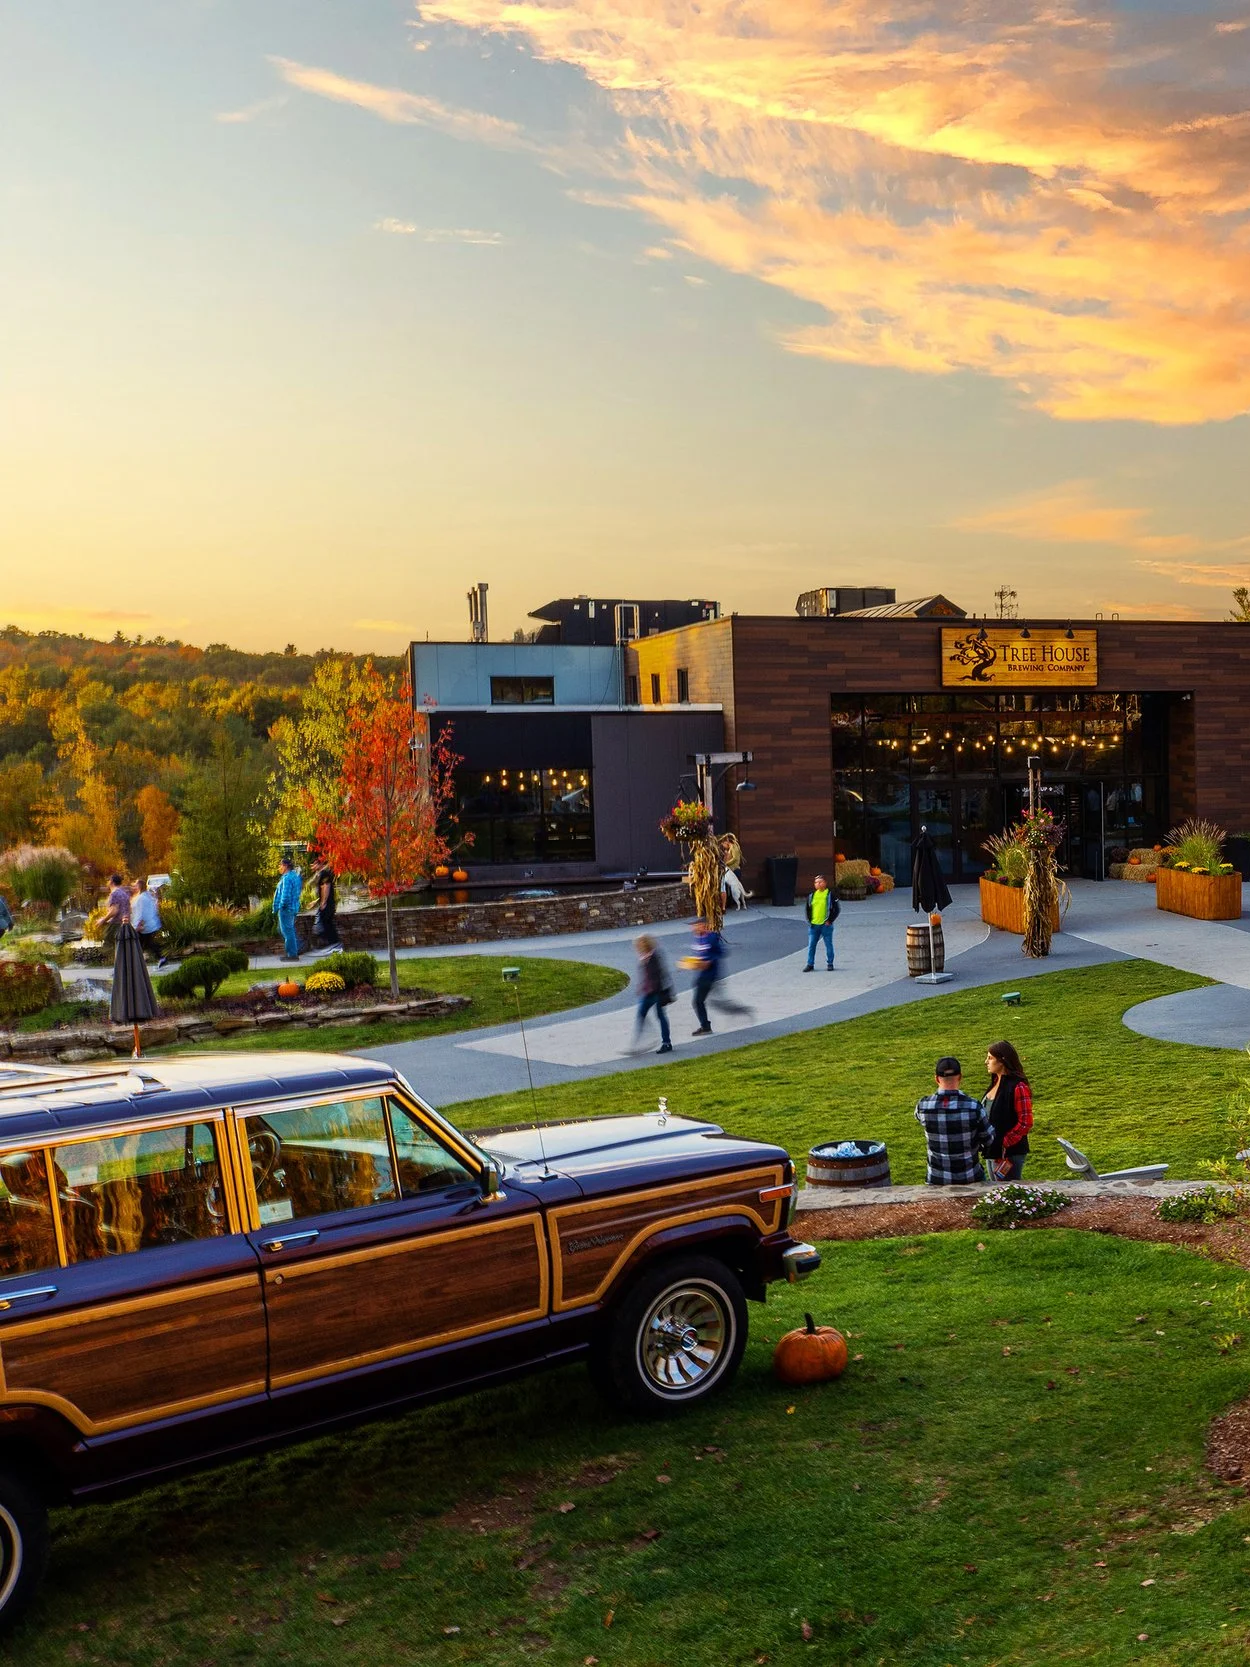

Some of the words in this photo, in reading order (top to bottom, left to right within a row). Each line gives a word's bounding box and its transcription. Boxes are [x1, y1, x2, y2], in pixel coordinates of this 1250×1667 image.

[999, 644, 1037, 662] TREE
[1041, 645, 1090, 662] HOUSE
[1007, 663, 1044, 672] BREWING
[1047, 663, 1086, 672] COMPANY
